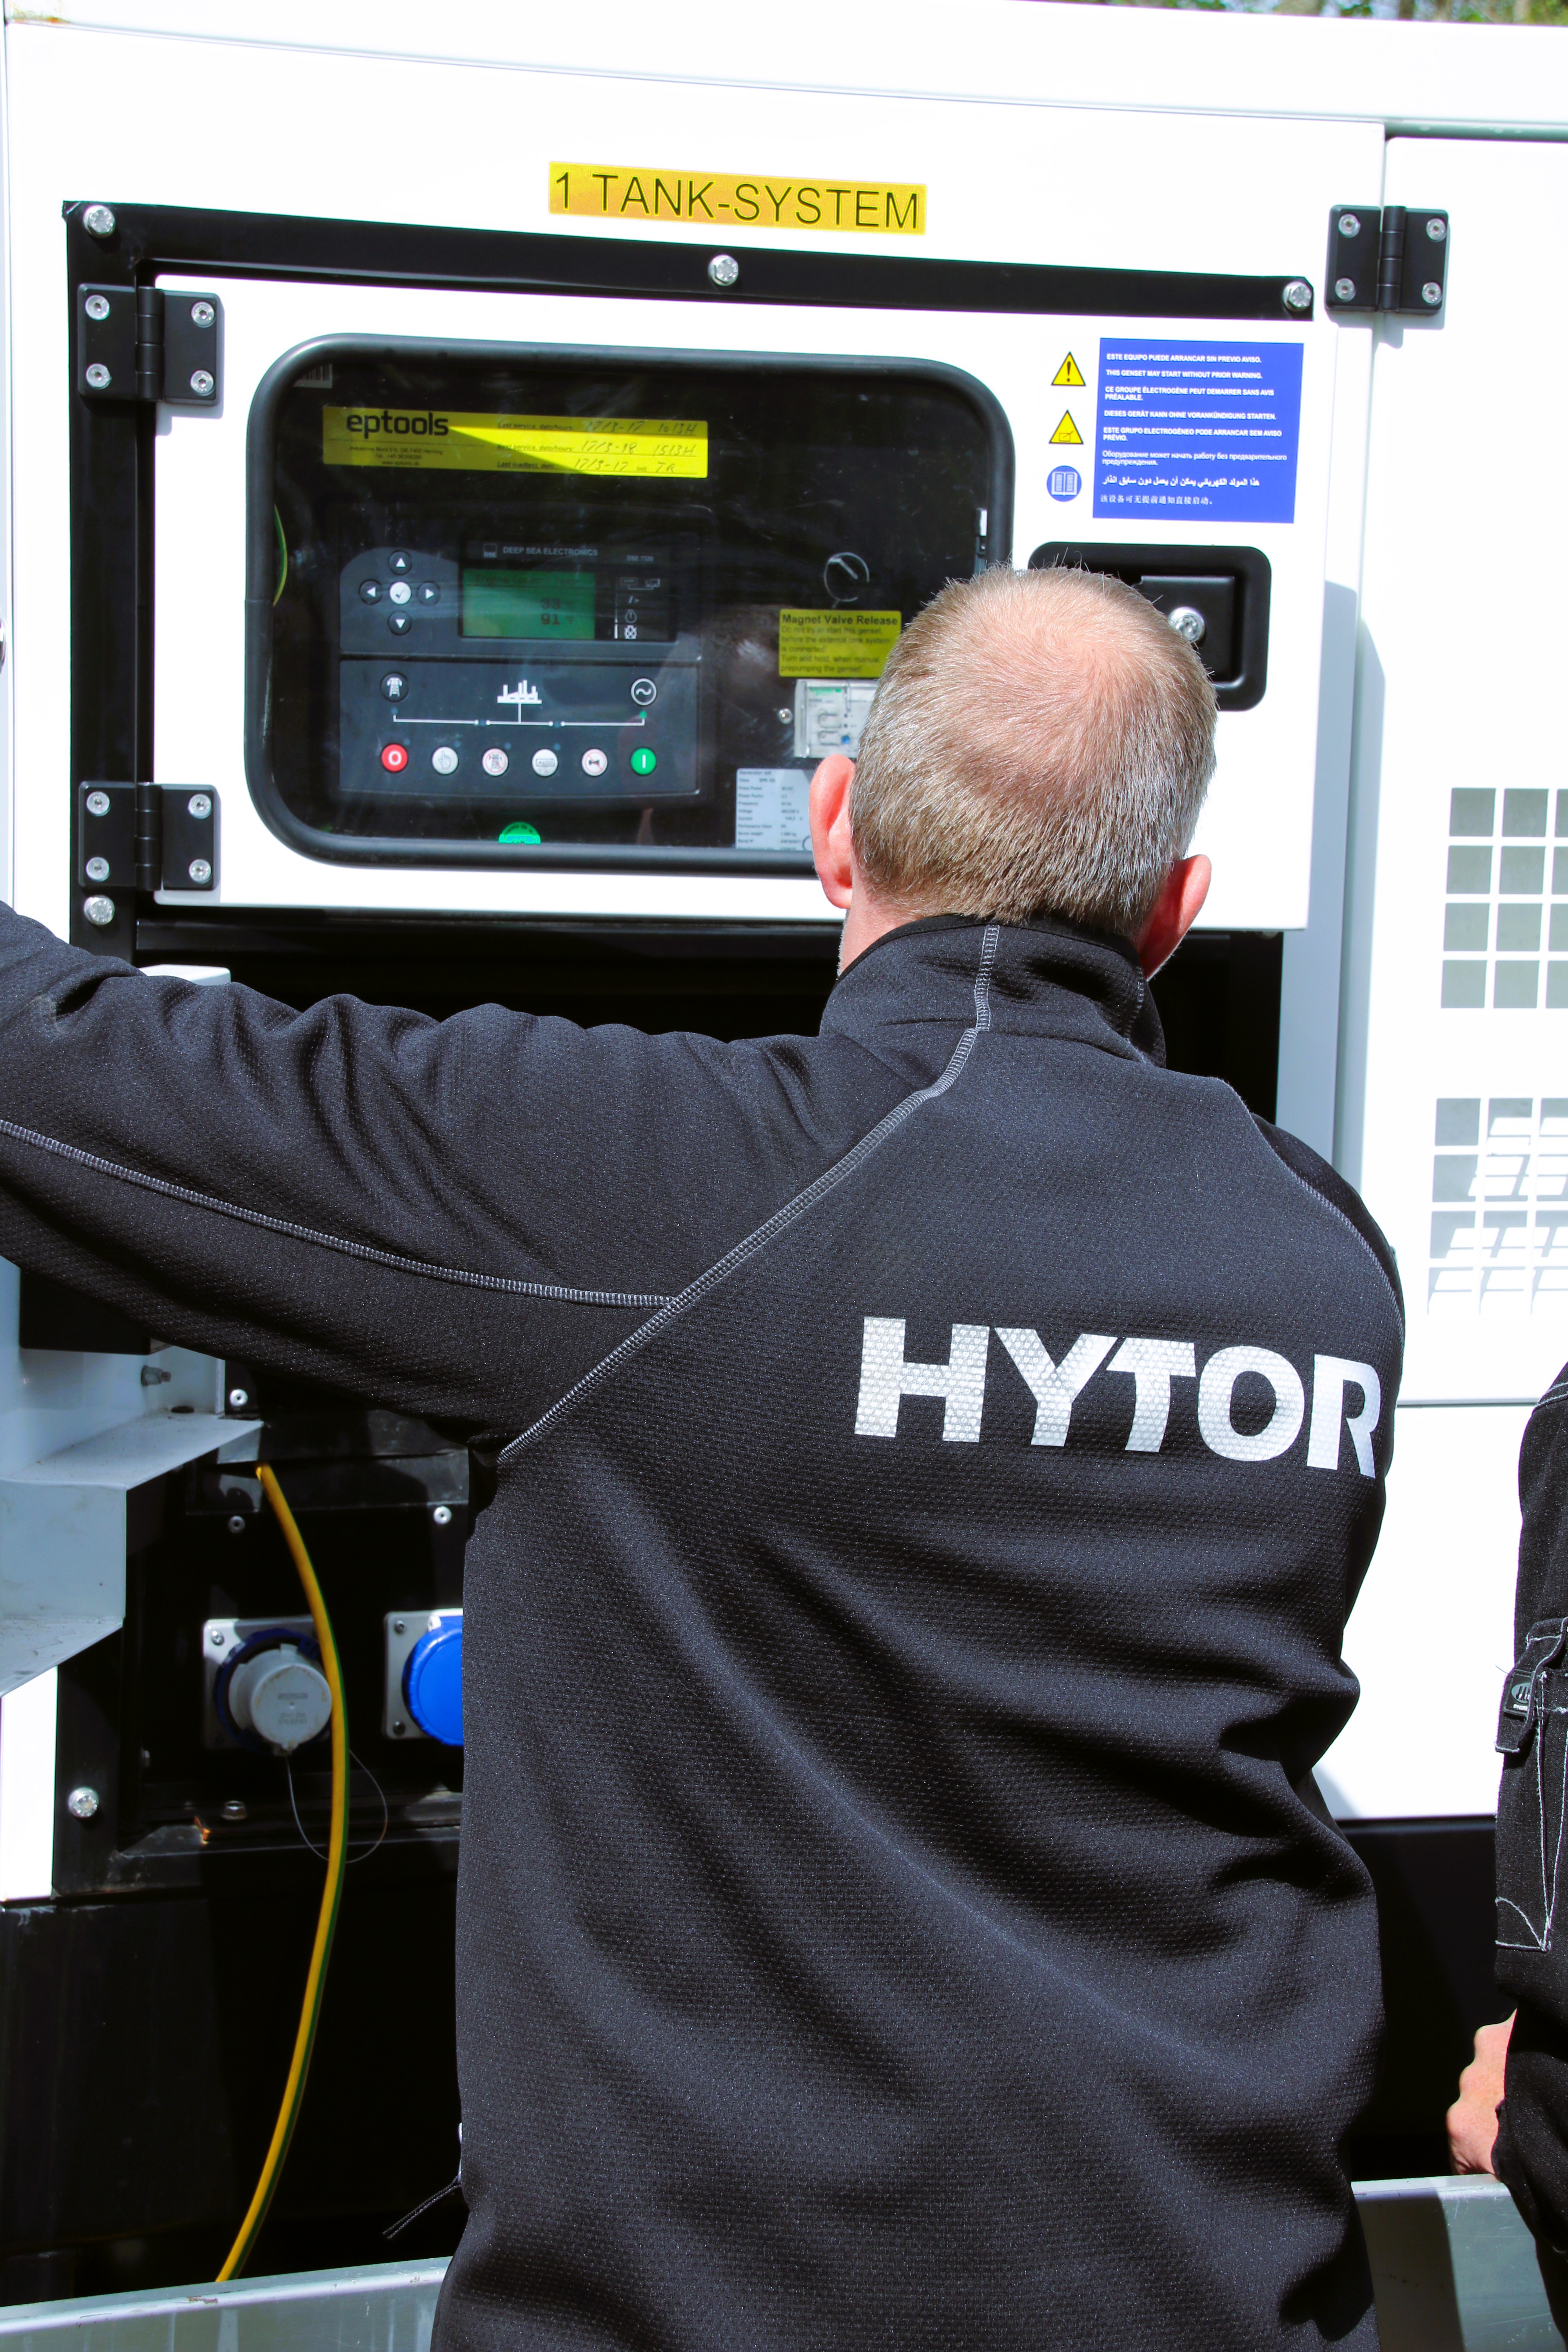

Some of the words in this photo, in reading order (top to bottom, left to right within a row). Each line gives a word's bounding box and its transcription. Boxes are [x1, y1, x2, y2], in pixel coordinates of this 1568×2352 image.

[555, 171, 570, 209] 1
[591, 173, 918, 230] TANK-SYSTEM
[1142, 386, 1188, 394] ÉLECTROGÈNE
[347, 410, 449, 439] eptools
[1143, 427, 1194, 436] ELECTROGÉNEO
[1102, 450, 1149, 459] Оборудование
[1194, 452, 1216, 461] работу
[1119, 476, 1136, 486] سابق
[1138, 477, 1152, 486] دون
[1153, 477, 1169, 486] يعمل
[1170, 476, 1178, 486] أن
[1180, 477, 1196, 487] يمكن
[1229, 478, 1248, 487] المولد
[1249, 477, 1259, 486] هذا
[503, 546, 523, 554] DEEP
[543, 547, 598, 556] ELECTRONICS
[782, 614, 820, 626] Magnet
[824, 615, 853, 624] Valve
[857, 615, 898, 625] Release
[854, 1316, 1381, 1479] HYTOR
